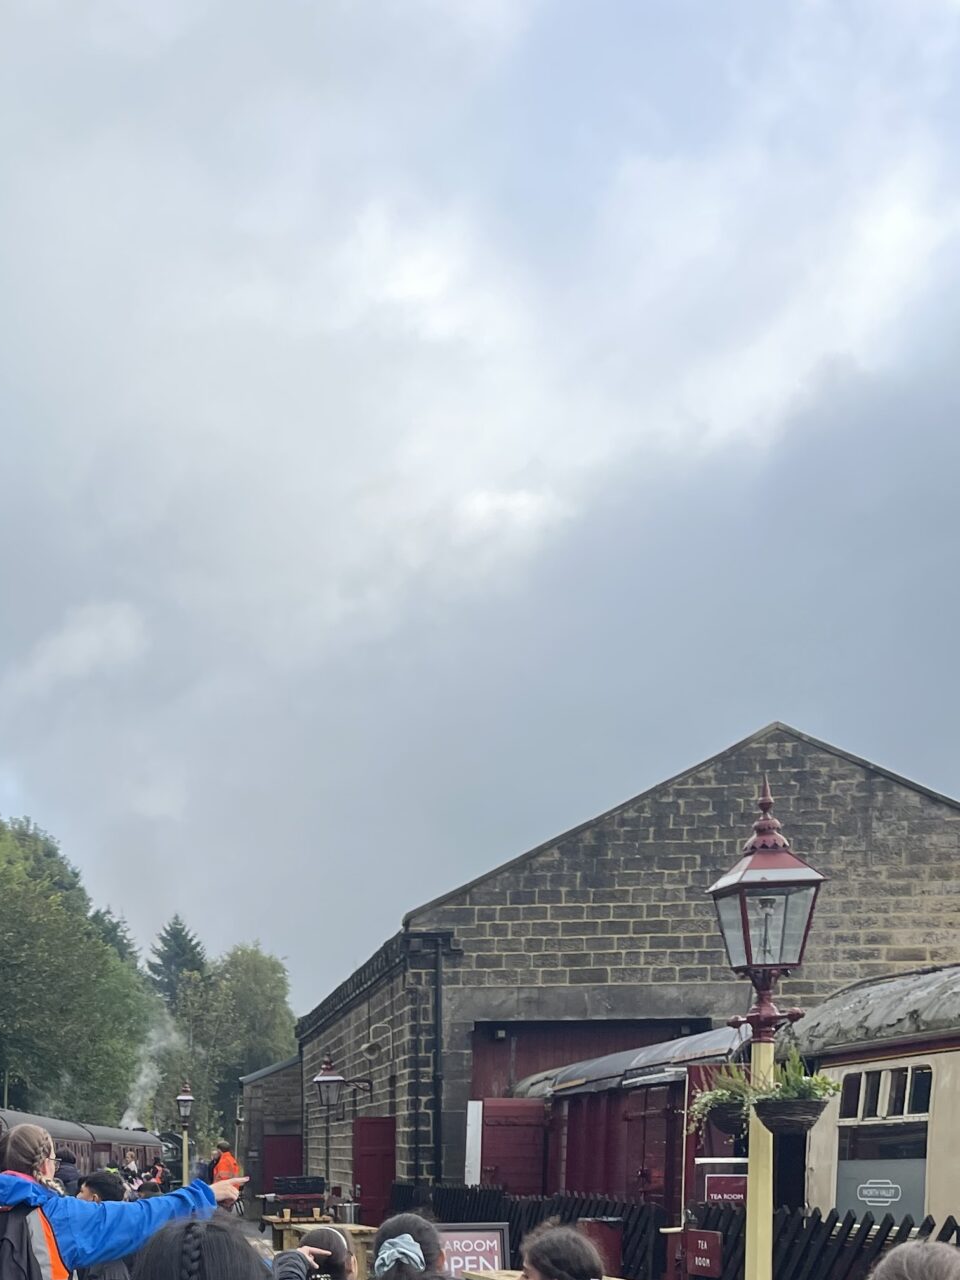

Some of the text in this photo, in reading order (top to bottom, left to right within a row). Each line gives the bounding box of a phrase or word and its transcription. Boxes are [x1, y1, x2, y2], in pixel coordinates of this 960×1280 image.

[444, 1240, 498, 1252] AROOM
[698, 1240, 707, 1250] TEA
[444, 1256, 499, 1277] PEN
[695, 1257, 710, 1267] ROOM
